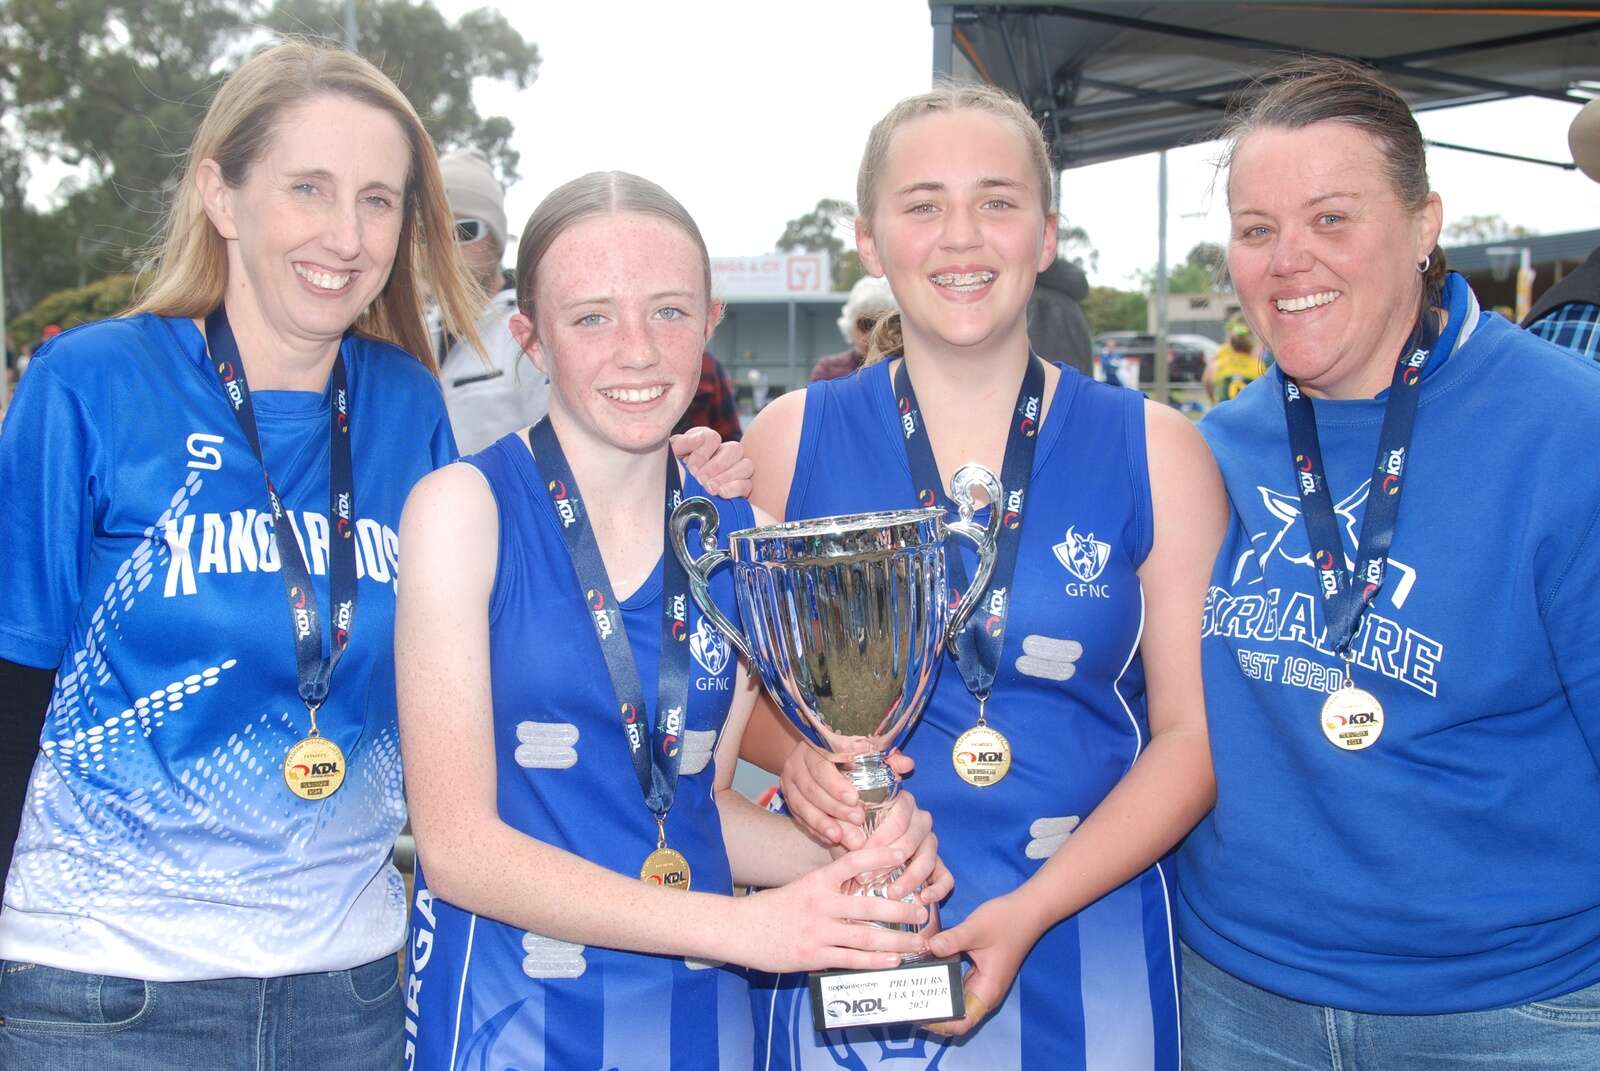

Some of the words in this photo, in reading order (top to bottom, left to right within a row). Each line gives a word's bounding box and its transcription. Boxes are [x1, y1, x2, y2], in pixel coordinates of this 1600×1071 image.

[1408, 349, 1429, 367] KDL
[226, 380, 243, 410] KDL
[1287, 381, 1300, 401] DL
[1024, 396, 1039, 420] KDL
[902, 412, 915, 438] KDL
[1387, 447, 1404, 475] KDL
[1301, 471, 1315, 496] KDL
[338, 492, 349, 519] KDL
[1008, 488, 1023, 512] KDL
[557, 499, 576, 528] KDL
[1321, 569, 1338, 599] KDL
[1366, 557, 1382, 585] KDL
[990, 587, 1006, 616] KDL
[1065, 582, 1110, 598] GFNC
[337, 600, 351, 630] KDL
[674, 593, 685, 621] KDL
[296, 608, 310, 640] KDL
[595, 609, 612, 639] KDL
[1201, 586, 1443, 697] GIRGARE
[695, 676, 730, 691] GFNC
[1237, 649, 1279, 681] EST
[1282, 656, 1343, 695] 1920
[665, 706, 681, 736] KDL
[1349, 712, 1379, 725] KDL
[628, 723, 640, 752] KDL
[311, 762, 341, 775] KDL
[977, 751, 1006, 763] KDL
[664, 870, 686, 884] KDL
[889, 976, 943, 989] PREMIERS
[911, 987, 948, 998] UNDER
[852, 997, 888, 1014] KDL
[908, 1000, 929, 1010] 2024
